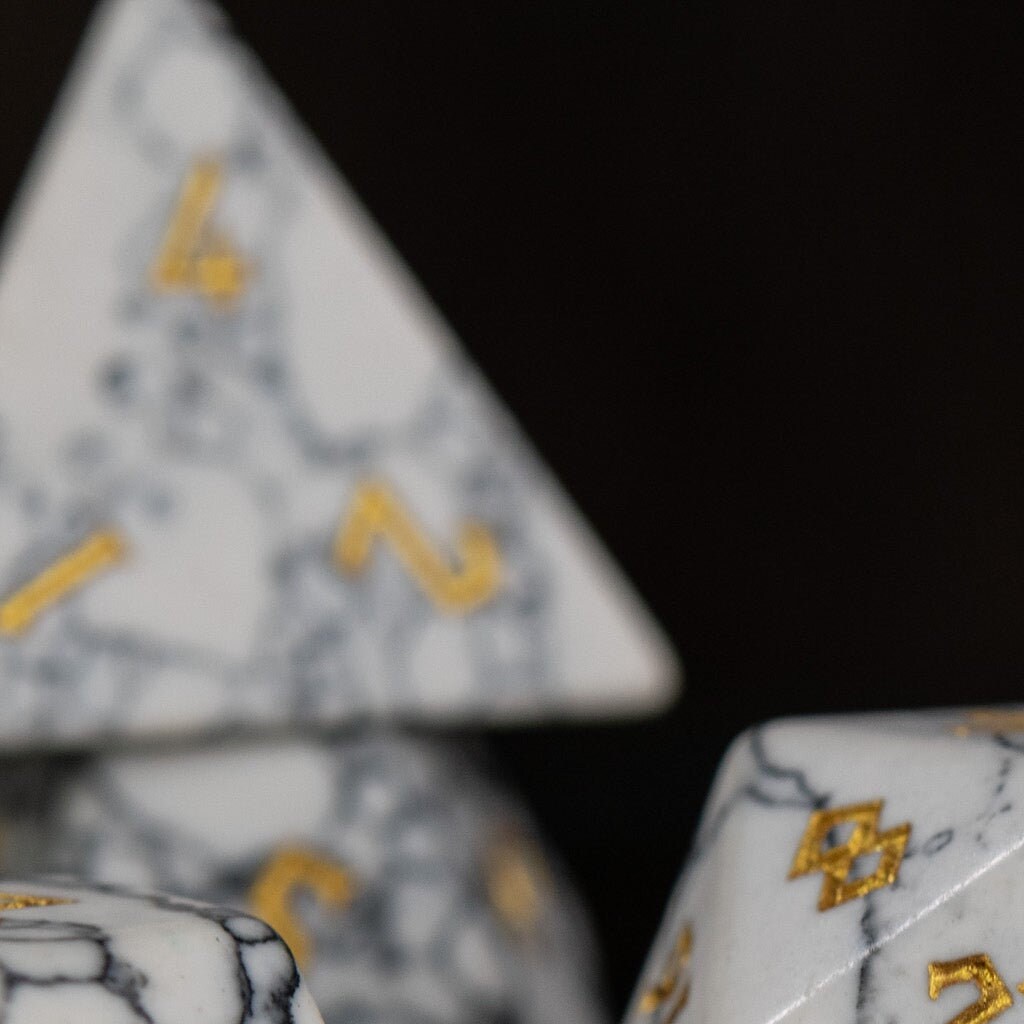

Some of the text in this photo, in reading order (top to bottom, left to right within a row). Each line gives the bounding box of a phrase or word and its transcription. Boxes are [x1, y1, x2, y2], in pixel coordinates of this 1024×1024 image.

[150, 155, 258, 312] 4
[334, 478, 508, 615] 2
[787, 798, 913, 913] 8
